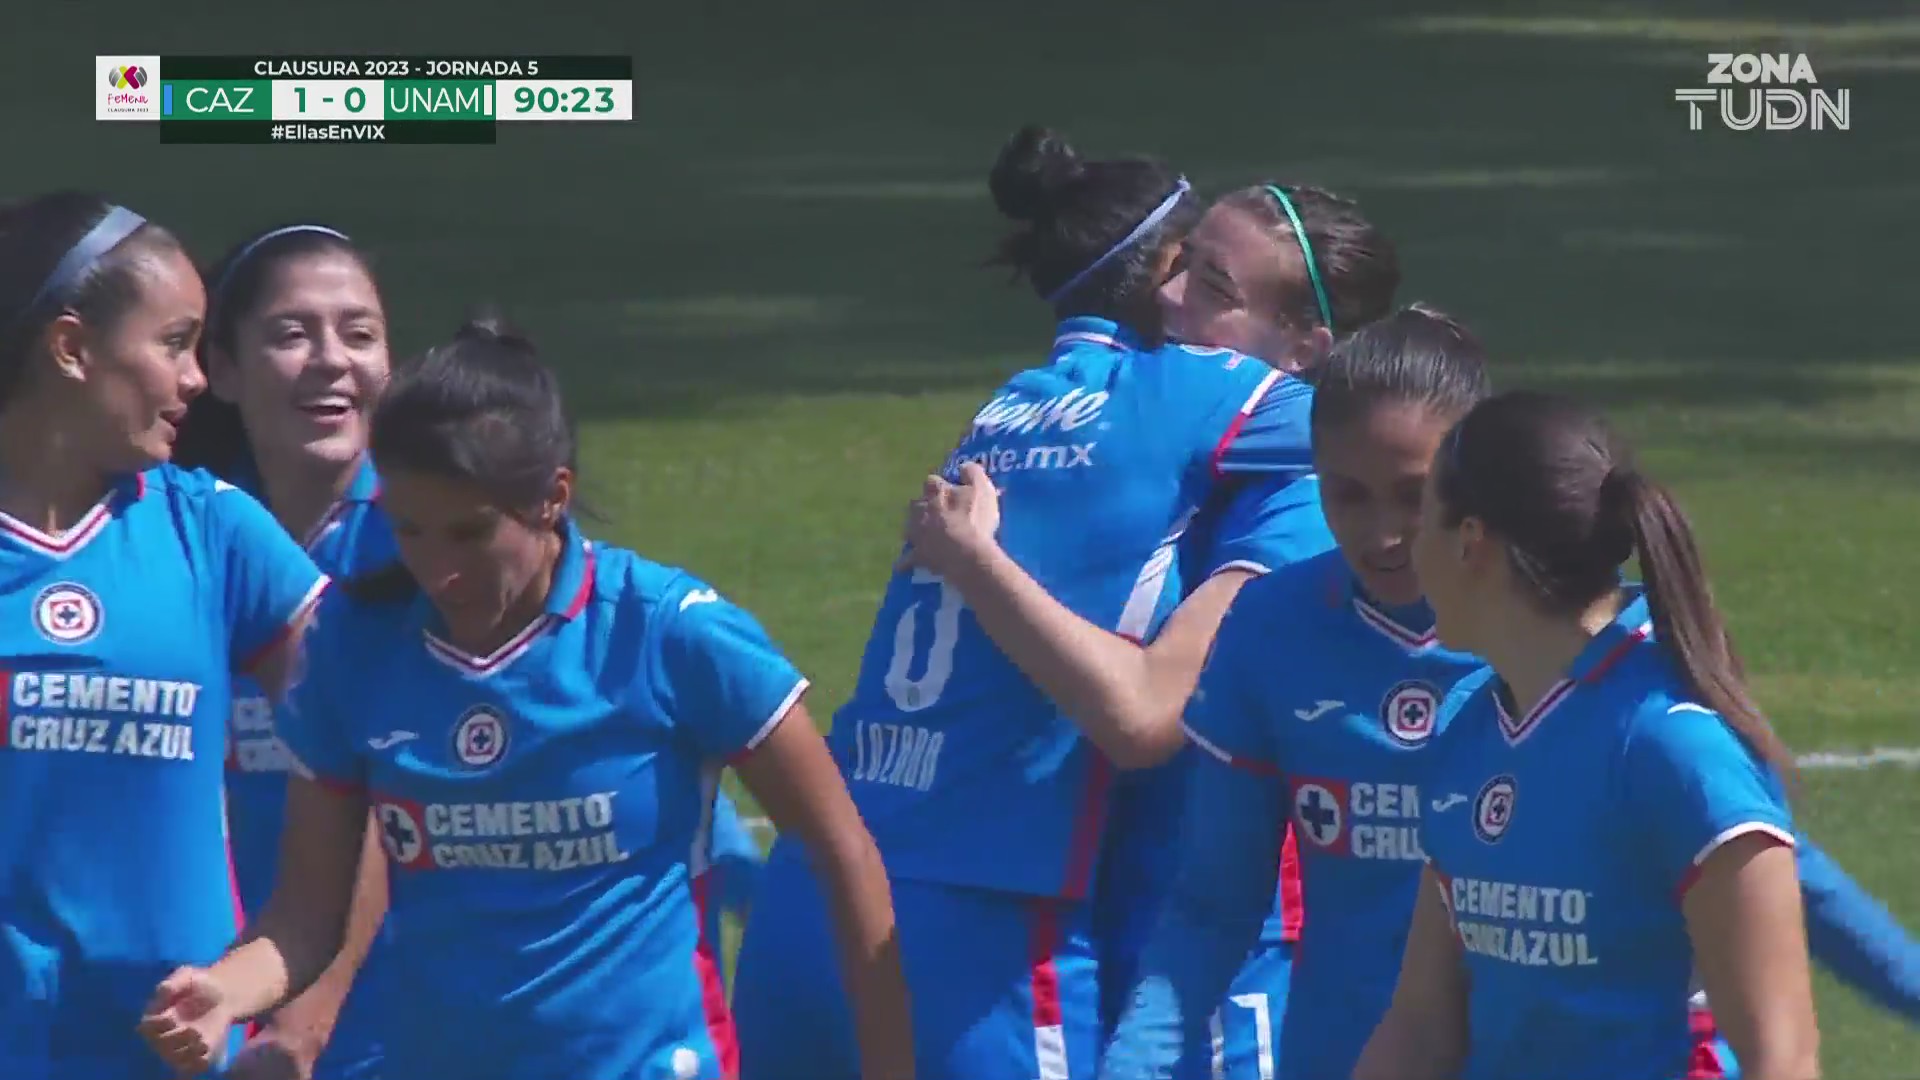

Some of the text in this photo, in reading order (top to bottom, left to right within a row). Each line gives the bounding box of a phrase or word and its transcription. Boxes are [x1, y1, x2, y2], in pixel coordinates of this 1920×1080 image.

[12, 671, 198, 717] CEMENTO
[11, 714, 110, 753] CRUZ
[113, 719, 195, 761] AZUL
[425, 792, 613, 837] CEMENTO
[431, 830, 629, 871] CRUZ AZUL
[1351, 824, 1426, 861] CRU
[1451, 877, 1587, 925] CEMENTO
[1509, 928, 1598, 967] AZUL
